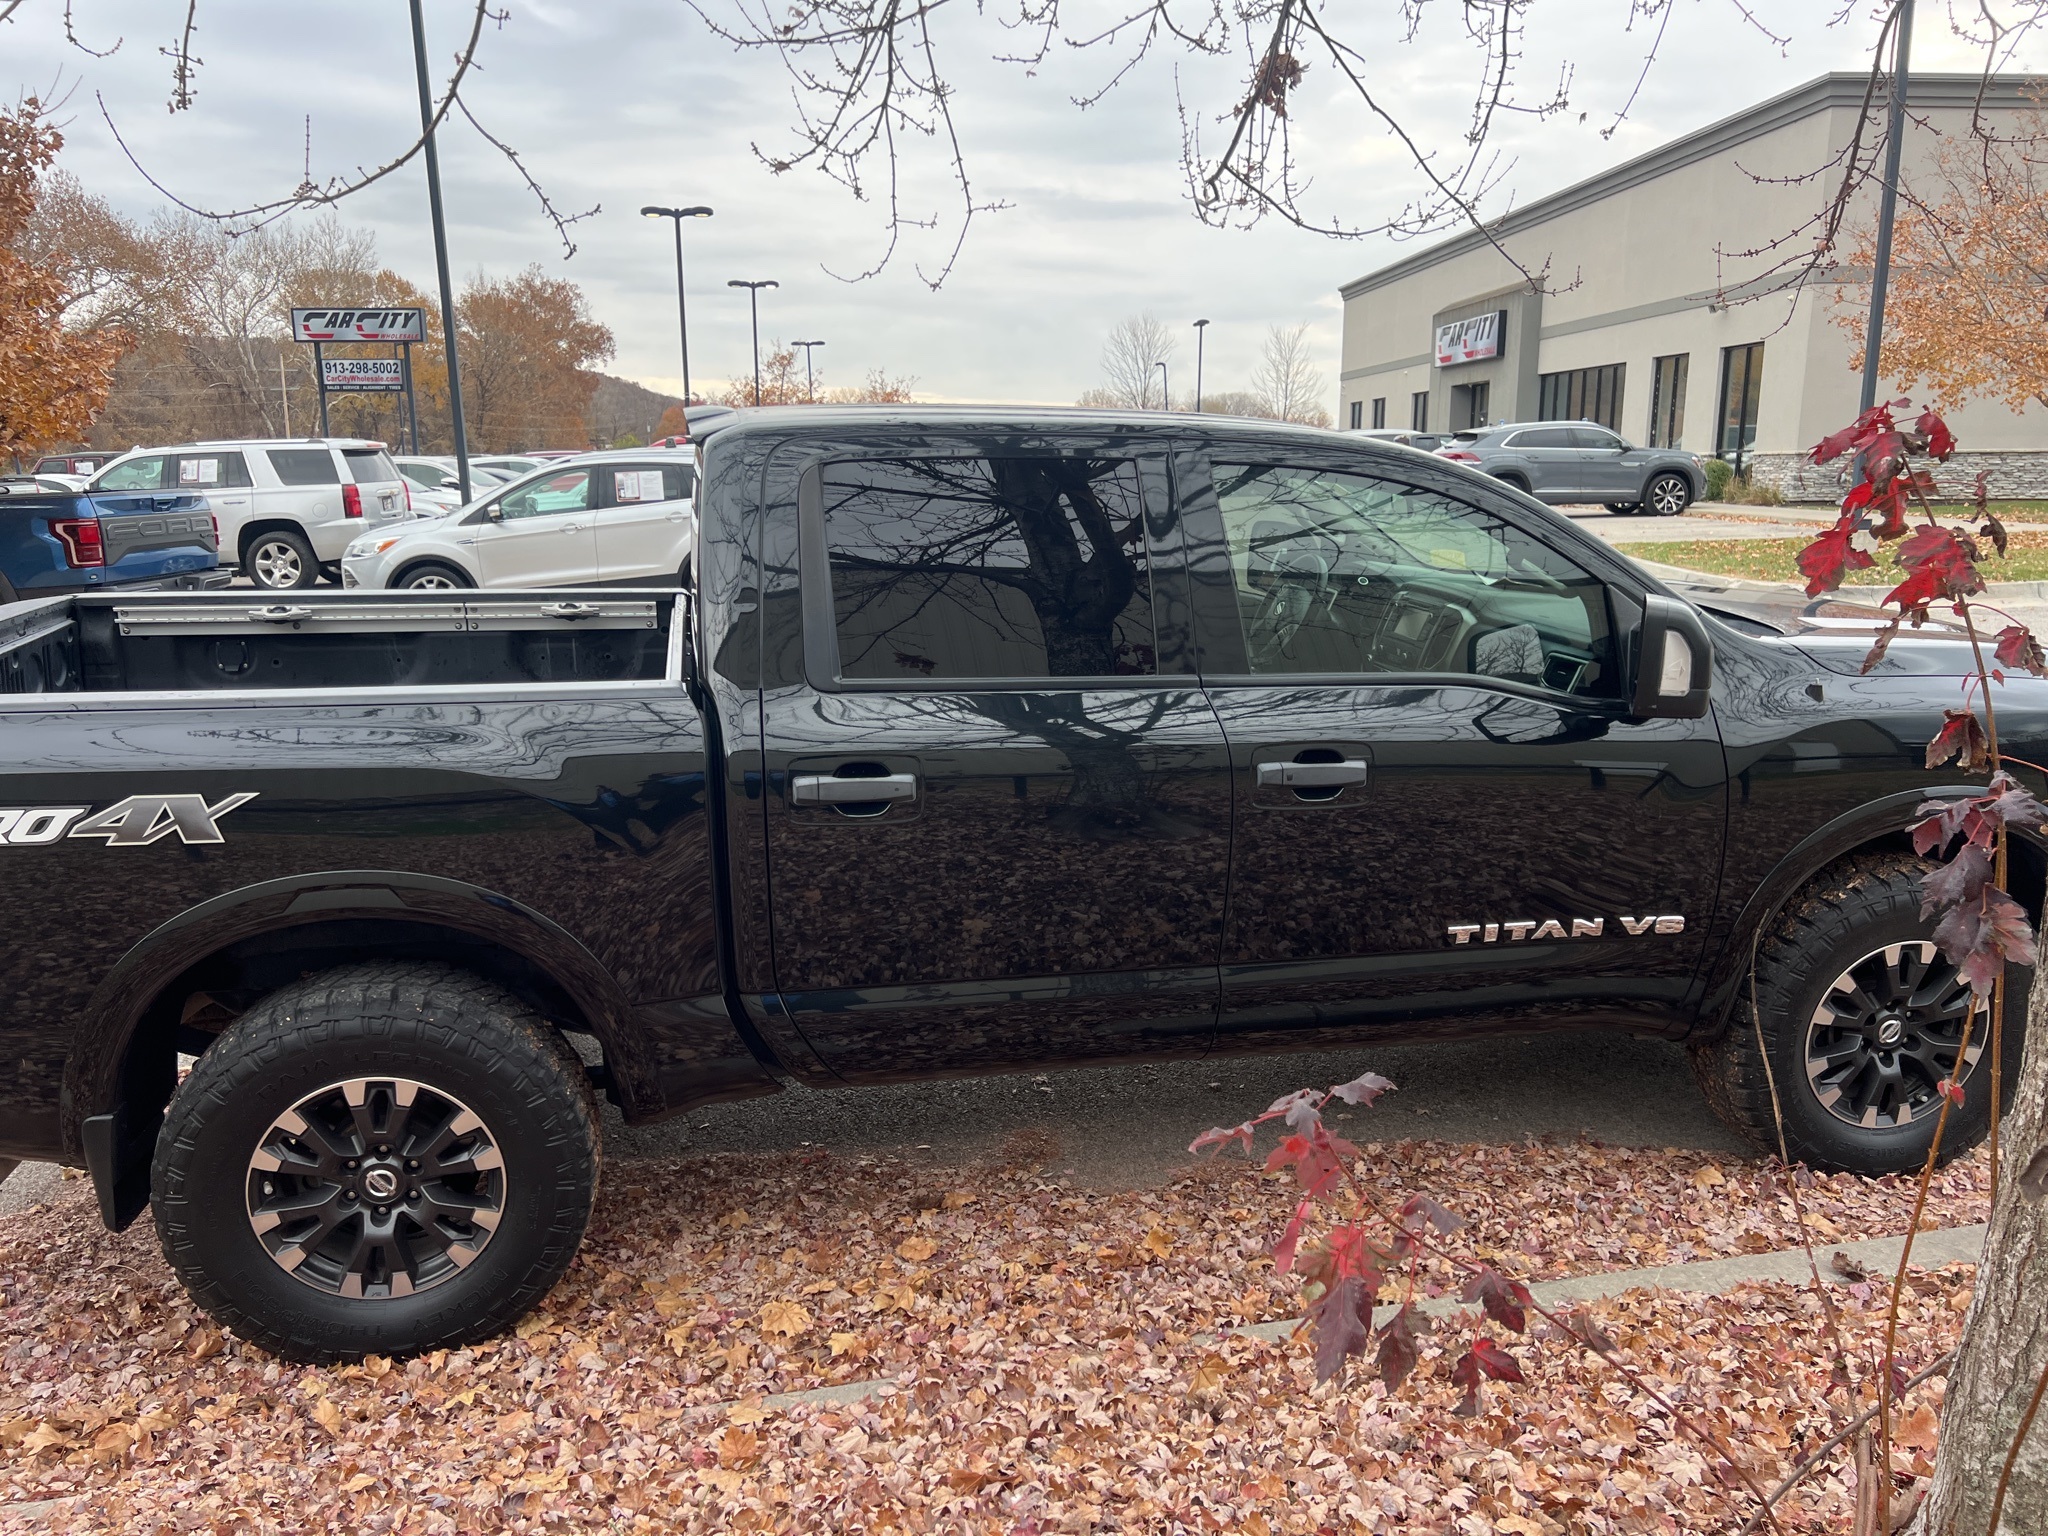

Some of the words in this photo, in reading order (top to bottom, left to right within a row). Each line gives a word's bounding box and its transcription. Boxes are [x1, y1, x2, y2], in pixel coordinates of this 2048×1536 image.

[325, 362, 400, 374] 913-298-5002
[326, 374, 400, 383] CarCityWholesale.com
[106, 516, 214, 541] FORD
[1447, 917, 1604, 944] TITAN
[1619, 915, 1685, 935] V8
